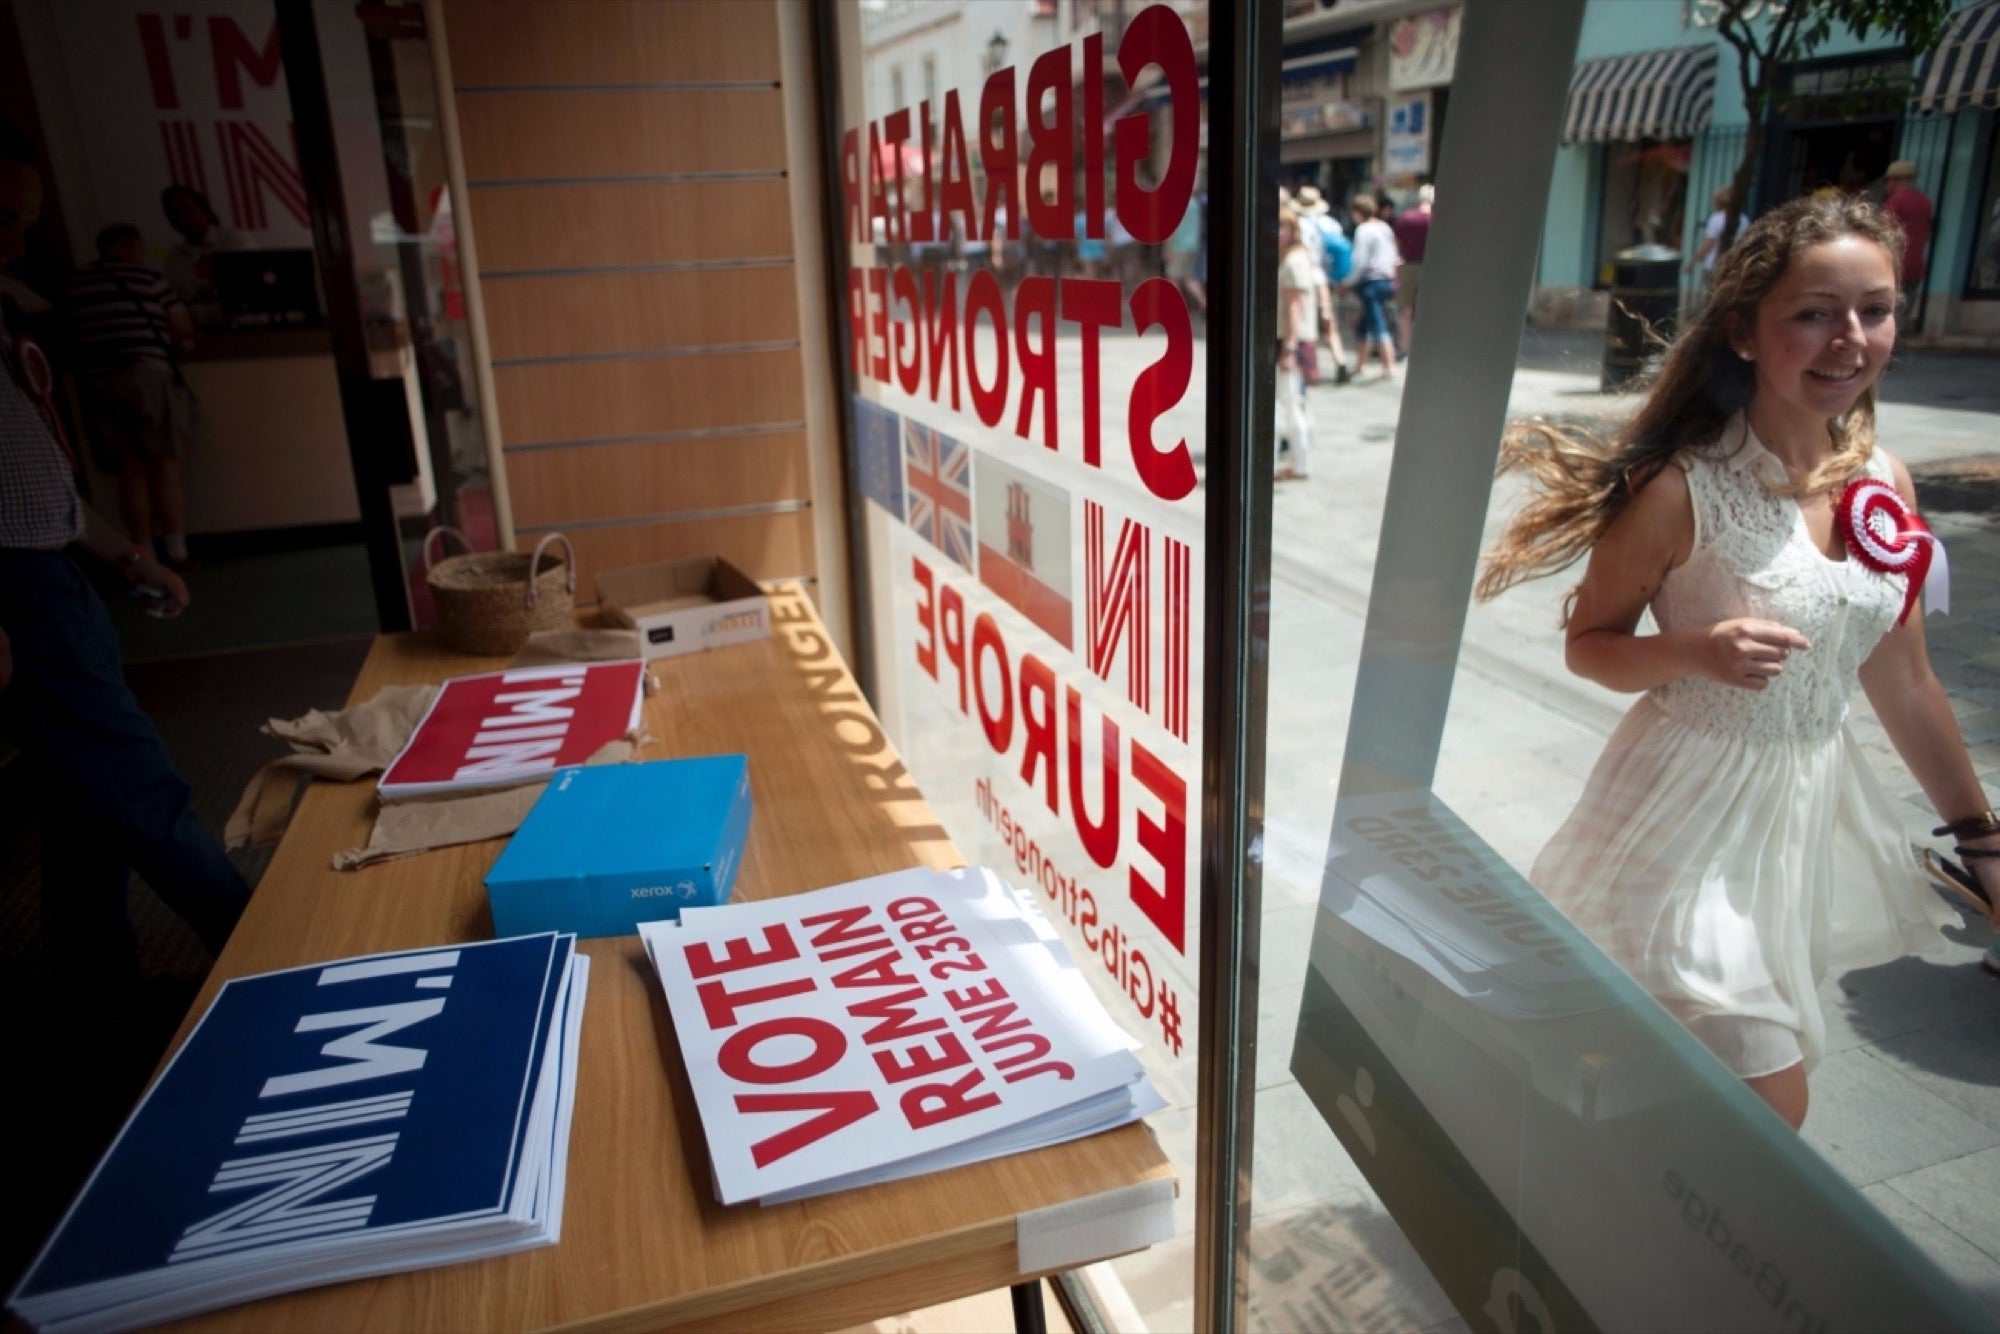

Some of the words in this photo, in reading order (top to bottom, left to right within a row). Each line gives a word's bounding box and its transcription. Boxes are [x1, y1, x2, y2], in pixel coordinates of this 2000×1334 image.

[136, 12, 284, 110] I'M
[158, 120, 311, 231] IN
[453, 722, 569, 781] IN
[481, 666, 588, 728] I'M
[630, 885, 674, 899] xerox
[885, 896, 990, 980] 23RD
[258, 950, 461, 1099] I'M
[683, 922, 880, 1170] VOTE
[800, 904, 1003, 1131] REMAIN
[943, 977, 1076, 1086] JUNE
[167, 1090, 415, 1264] IN
